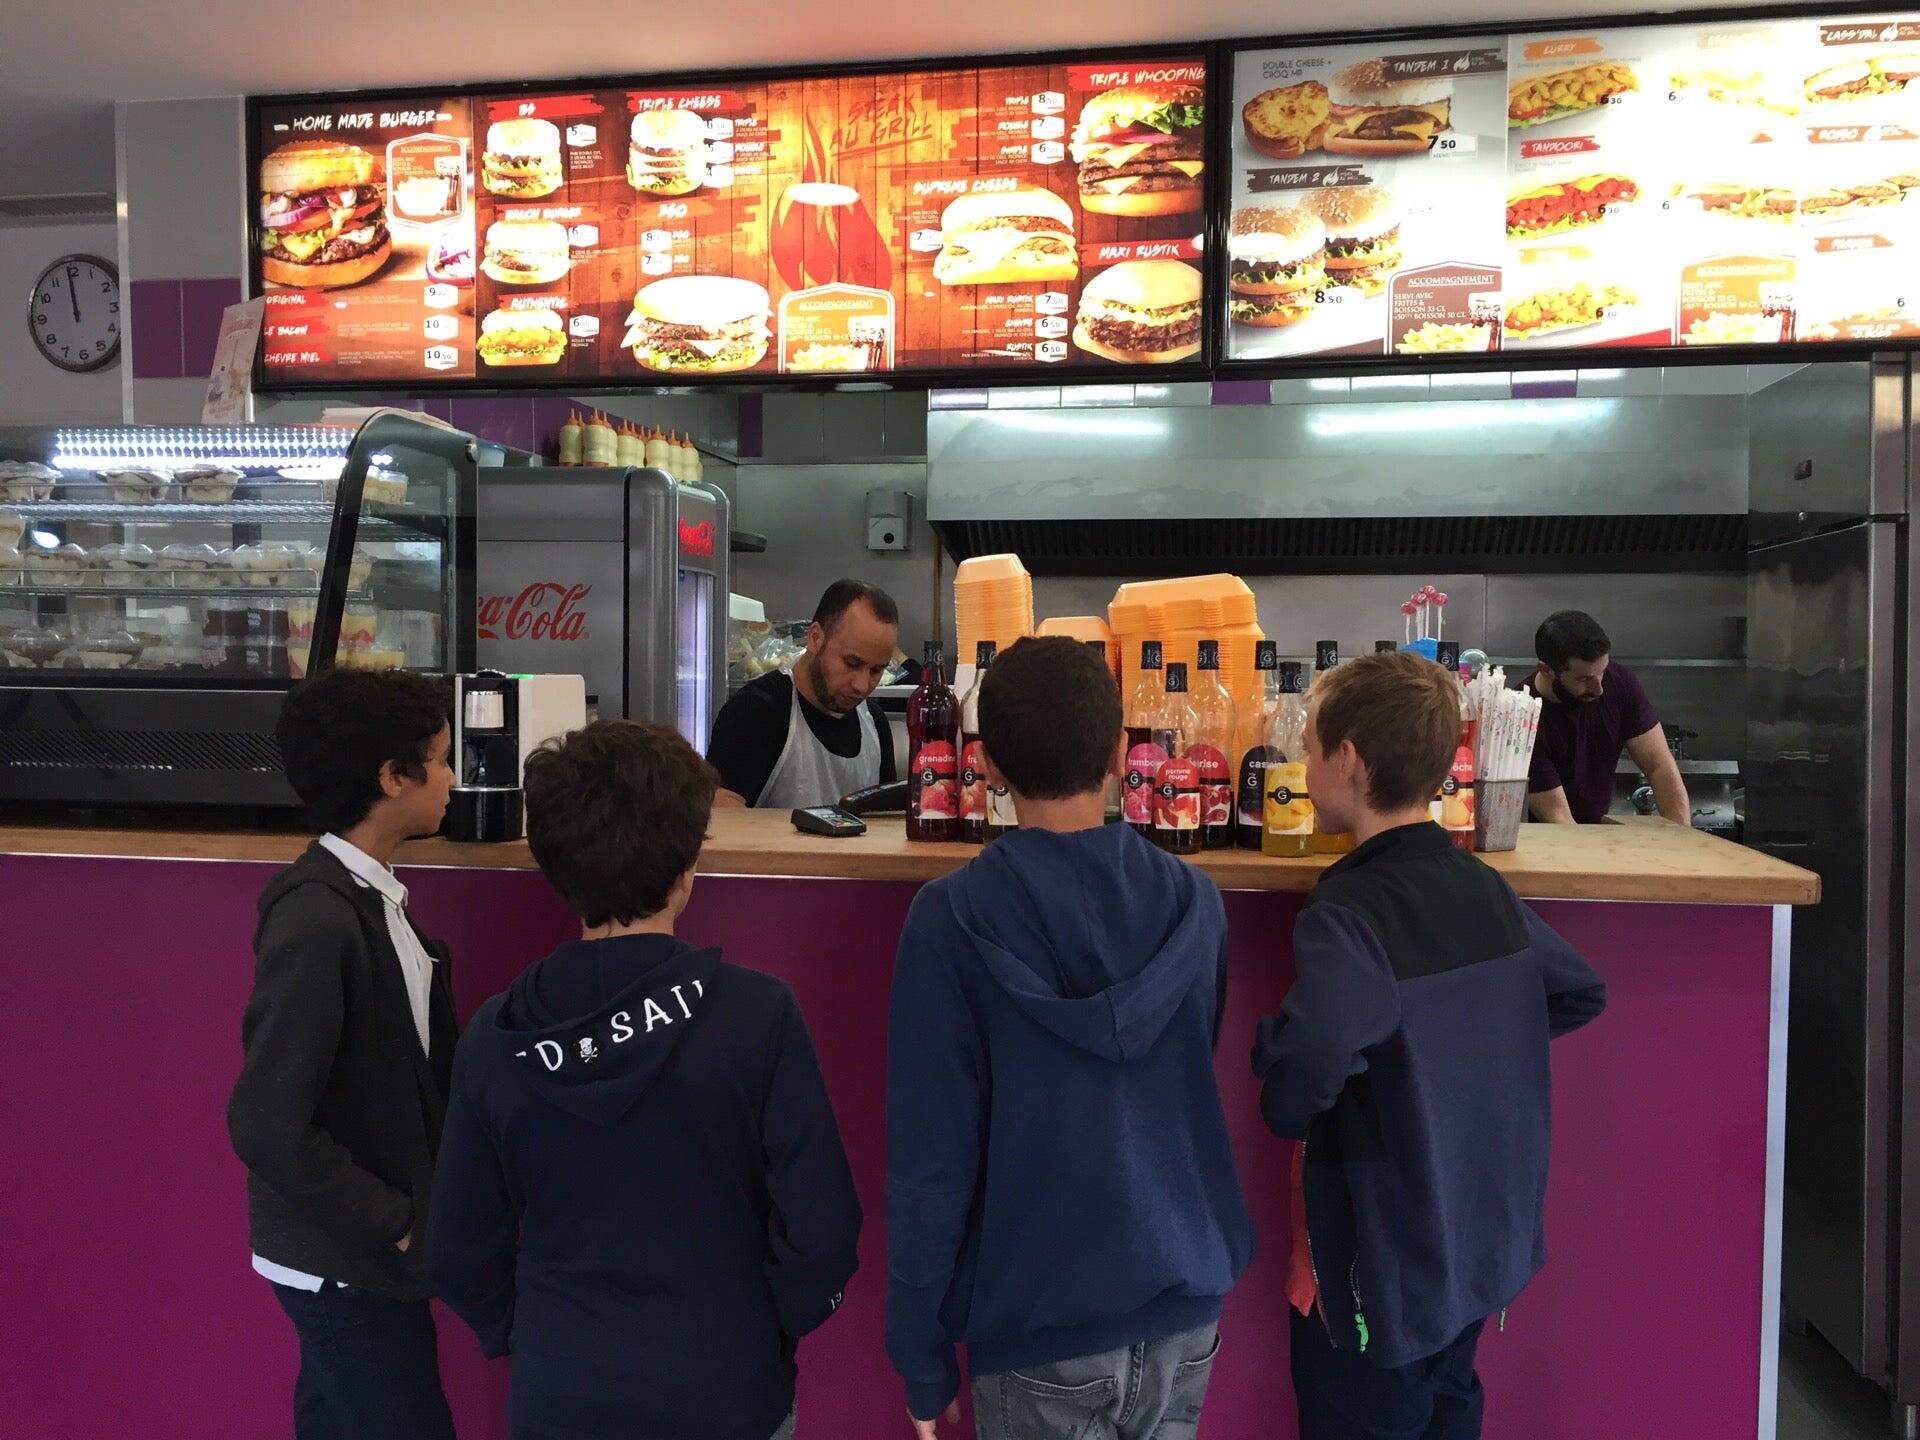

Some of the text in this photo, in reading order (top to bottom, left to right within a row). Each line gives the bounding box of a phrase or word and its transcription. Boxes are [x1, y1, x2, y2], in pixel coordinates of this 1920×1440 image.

[1543, 43, 1576, 55] CURRY
[1262, 60, 1293, 69] DOUBLE
[1296, 58, 1324, 67] CHEESE
[1393, 59, 1449, 73] TANDEM 1
[1090, 67, 1206, 86] TRIPLE WHOOPING
[1262, 69, 1289, 79] CROQ
[1038, 95, 1046, 104] 8
[1668, 91, 1677, 101] 6
[638, 95, 721, 111] TRIPLE CHEESE
[847, 92, 917, 122] STEAK
[293, 110, 436, 131] HOME MADE BURGER
[706, 120, 713, 129] 6
[1038, 118, 1045, 127] 7
[571, 126, 578, 136] 5
[830, 120, 860, 151] AU
[1427, 135, 1456, 149] 7 50
[1531, 140, 1584, 152] TANDOORI
[1039, 143, 1046, 153] 6
[706, 167, 713, 177] 4
[1269, 172, 1321, 185] TANDEM 2
[912, 178, 1018, 195] SUPREME CHEESE
[1900, 192, 1907, 201] 7
[1597, 204, 1606, 213] 6
[1662, 201, 1670, 210] 6
[571, 226, 579, 235] 6
[646, 232, 653, 241] 8
[916, 232, 922, 240] 7
[1100, 244, 1180, 259] MAXI RUSTIK
[646, 256, 652, 265] 7
[89, 269, 93, 279] 1
[52, 277, 60, 288] 11
[1407, 275, 1495, 286] ACCOMPAGNEMENT
[101, 282, 111, 293] 2
[429, 287, 436, 296] 9
[40, 293, 51, 304] 10
[266, 294, 306, 304] ORIGINAL
[1045, 295, 1052, 304] 7
[1314, 291, 1325, 304] 8
[109, 301, 119, 313] 3
[1897, 298, 1905, 308] 6
[1414, 312, 1446, 320] BOISSON
[1596, 307, 1604, 317] 6
[37, 314, 47, 325] 9
[426, 320, 440, 329] 10
[573, 318, 580, 327] 6
[1041, 318, 1049, 328] 6
[107, 322, 116, 333] 4
[264, 325, 308, 336] LE BACON
[46, 333, 57, 344] 8
[95, 340, 106, 351] 5
[1041, 343, 1049, 352] 6
[61, 346, 69, 358] 7
[79, 349, 89, 360] 6
[426, 351, 441, 359] 10
[300, 352, 320, 363] MIEL
[478, 582, 593, 640] a-Cola
[922, 771, 933, 781] G
[964, 771, 973, 781] G
[1130, 773, 1139, 784] G
[1247, 776, 1257, 786] G
[1443, 780, 1454, 790] G
[1162, 786, 1173, 795] G
[1277, 790, 1287, 800] G
